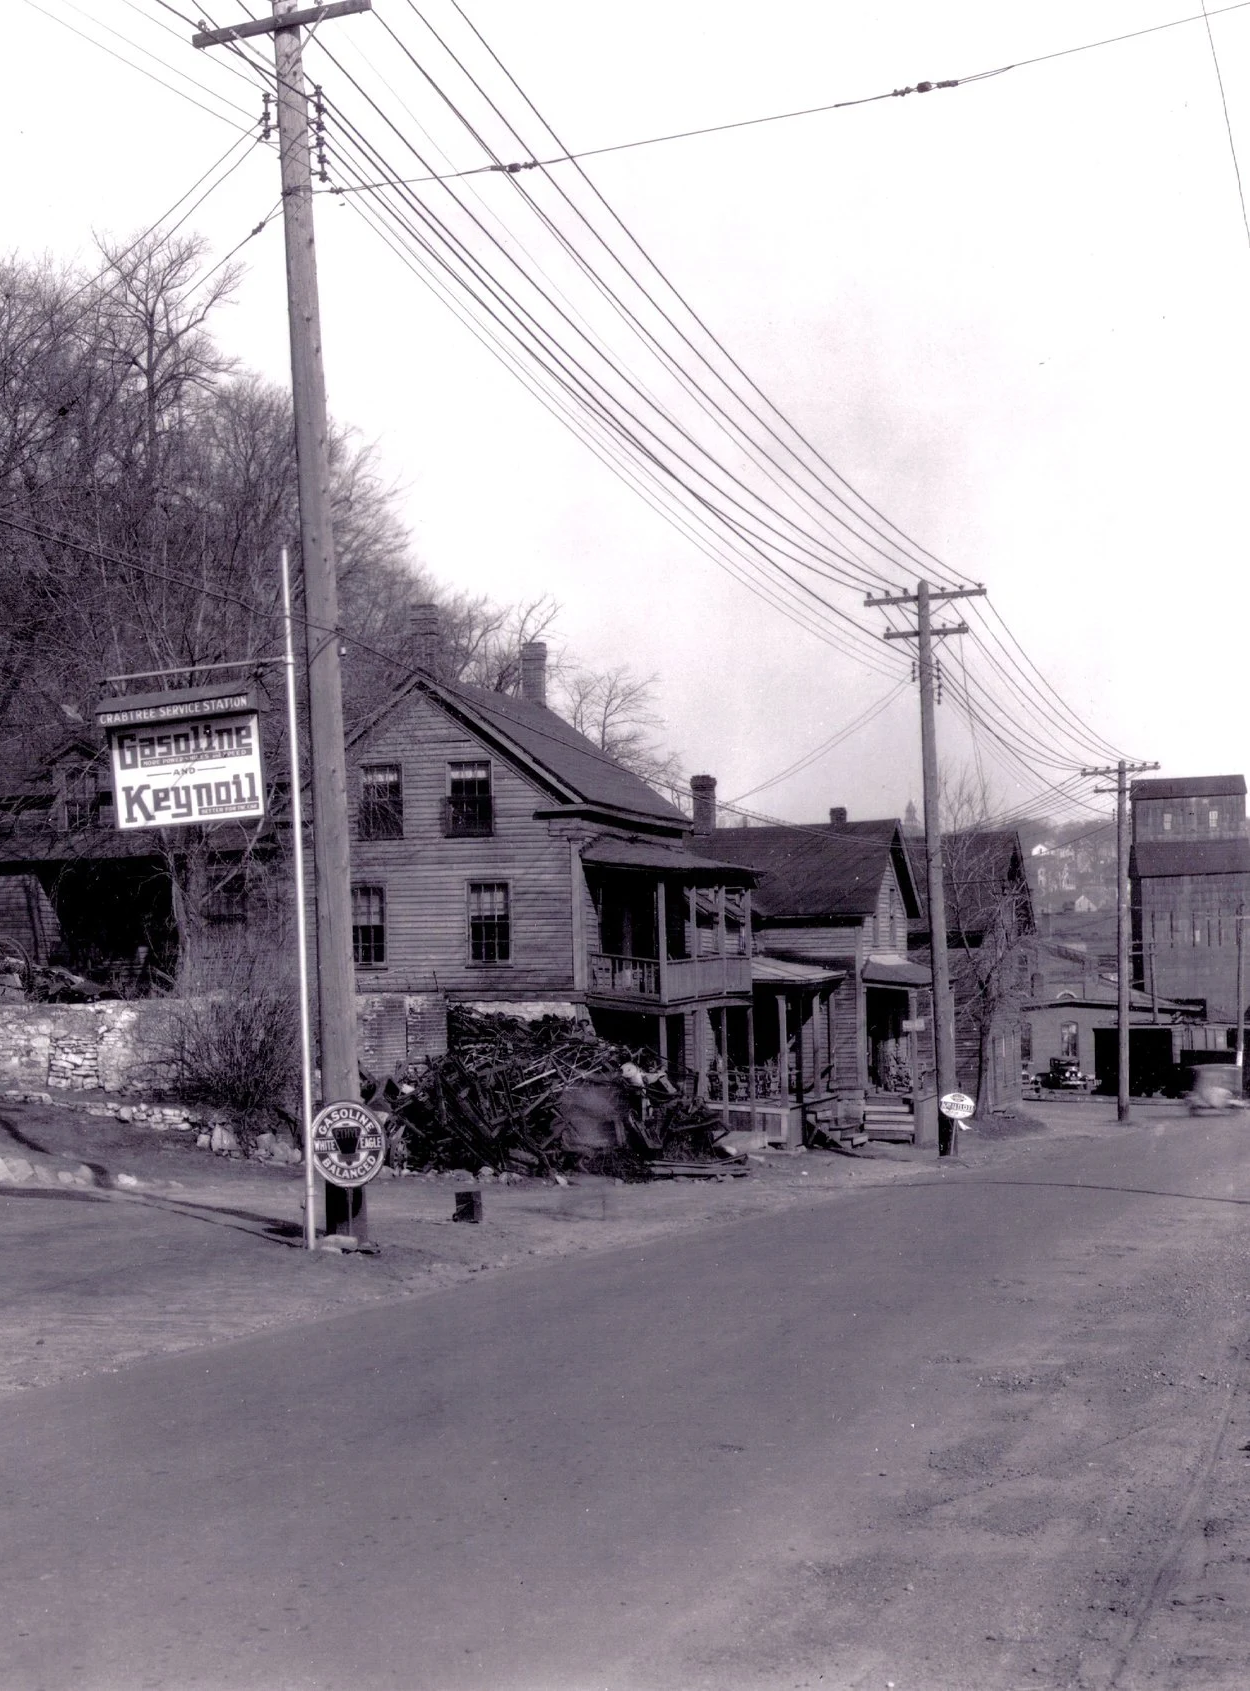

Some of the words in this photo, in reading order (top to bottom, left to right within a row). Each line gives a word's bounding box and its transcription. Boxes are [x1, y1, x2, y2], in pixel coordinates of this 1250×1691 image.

[100, 708, 157, 725] CRABTREE
[159, 701, 200, 719] SERVICE
[202, 695, 248, 712] STATION
[116, 724, 253, 770] Gasoline
[172, 767, 196, 776] AND
[121, 772, 260, 824] Keynoil
[318, 1108, 375, 1135] GASOLINE
[313, 1140, 337, 1151] WHITE
[360, 1137, 382, 1149] EAGLE
[321, 1155, 376, 1179] BALANCED
